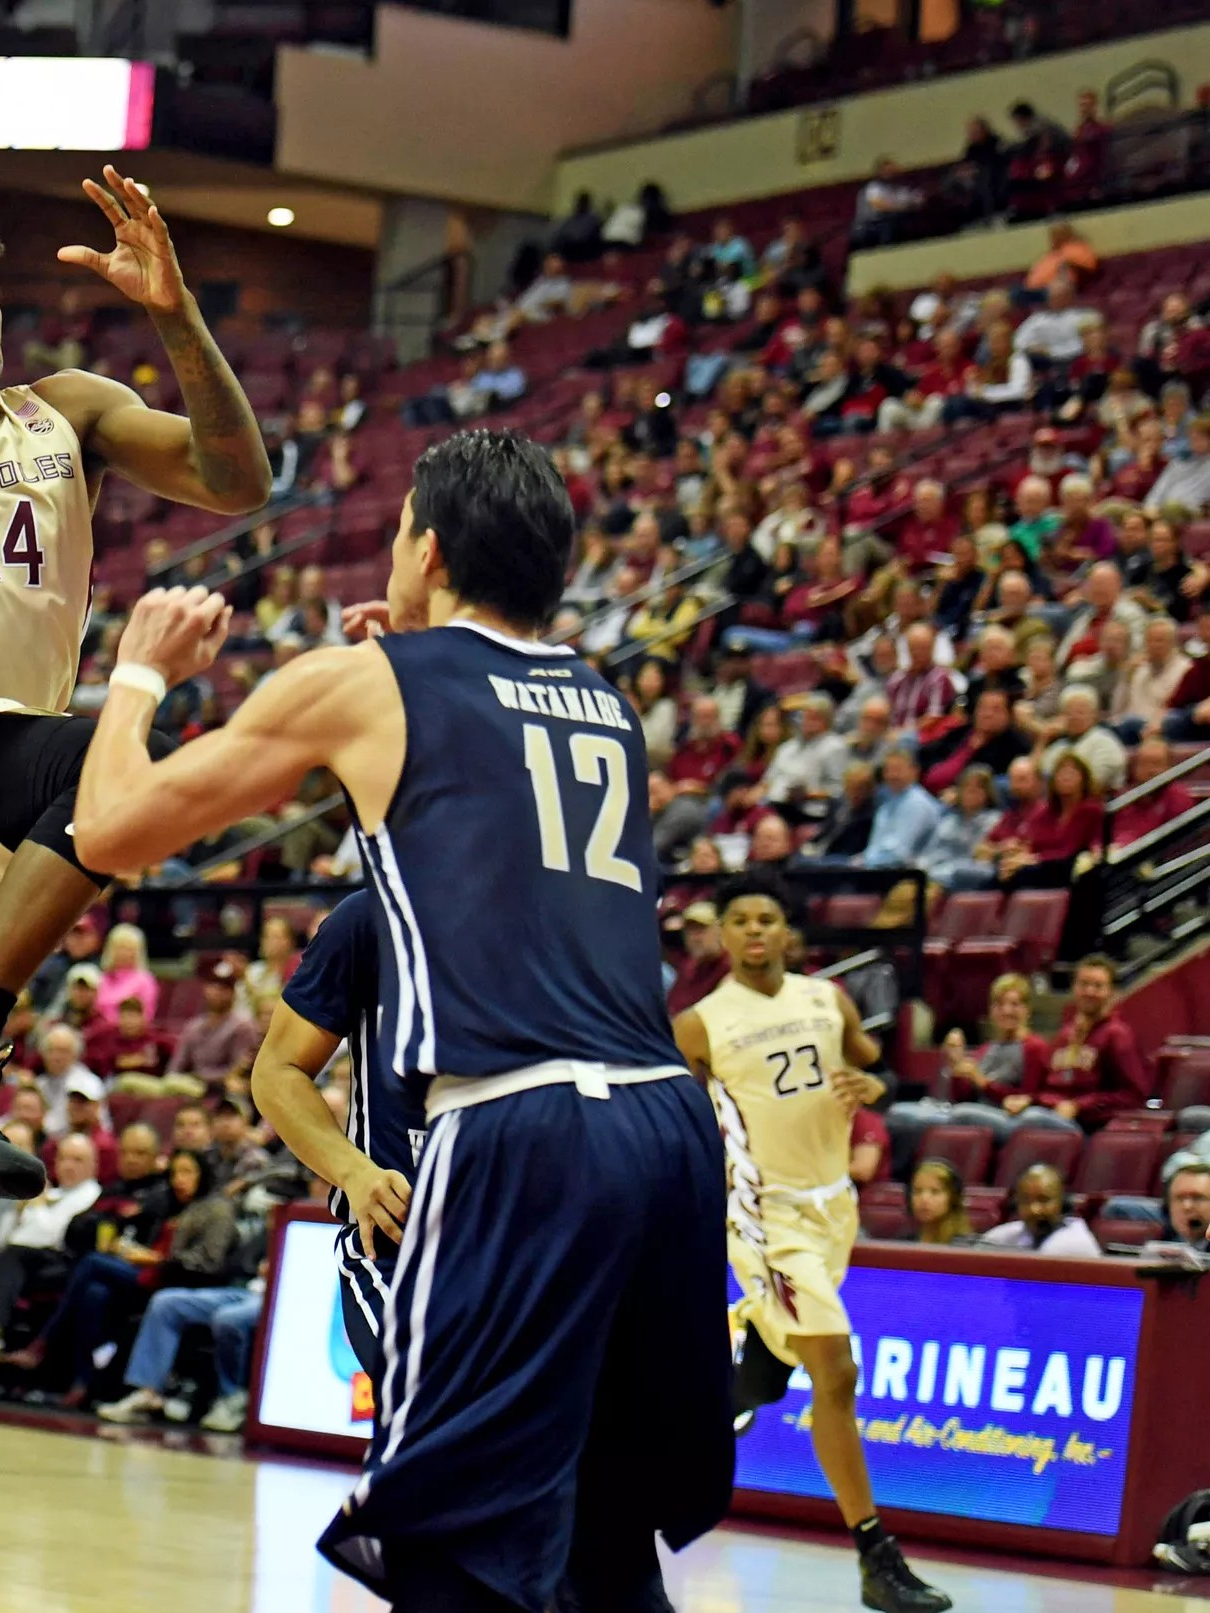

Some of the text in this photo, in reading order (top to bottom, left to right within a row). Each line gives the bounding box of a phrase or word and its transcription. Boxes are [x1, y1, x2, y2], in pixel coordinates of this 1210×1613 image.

[487, 673, 632, 732] WATANABE
[522, 722, 643, 894] 12
[766, 1043, 824, 1097] 23
[787, 1333, 1127, 1422] RINEAU
